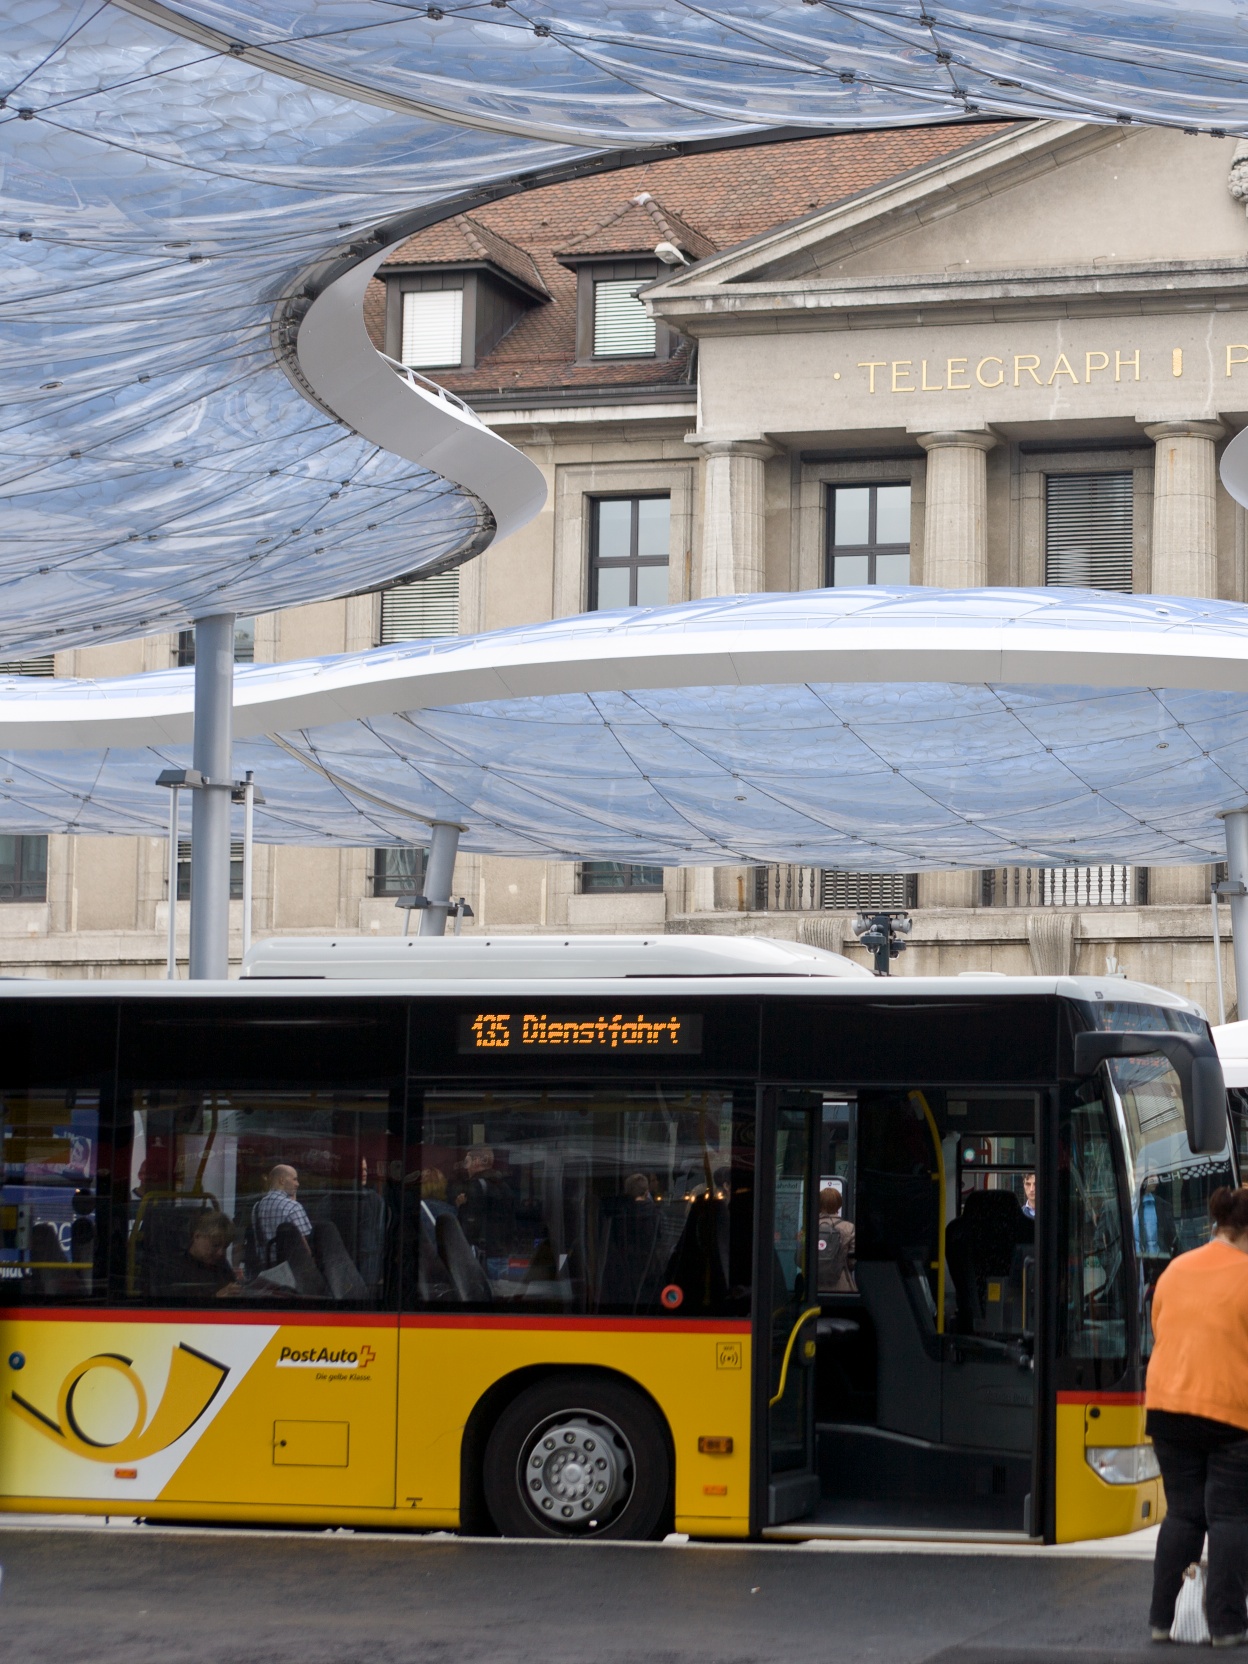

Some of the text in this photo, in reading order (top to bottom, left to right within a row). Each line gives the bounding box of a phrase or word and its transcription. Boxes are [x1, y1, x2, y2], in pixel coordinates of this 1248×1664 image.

[857, 350, 1141, 393] TELEGRAPH
[471, 1015, 681, 1047] 135 Dienstfahrt
[280, 1347, 358, 1363] PostAuto
